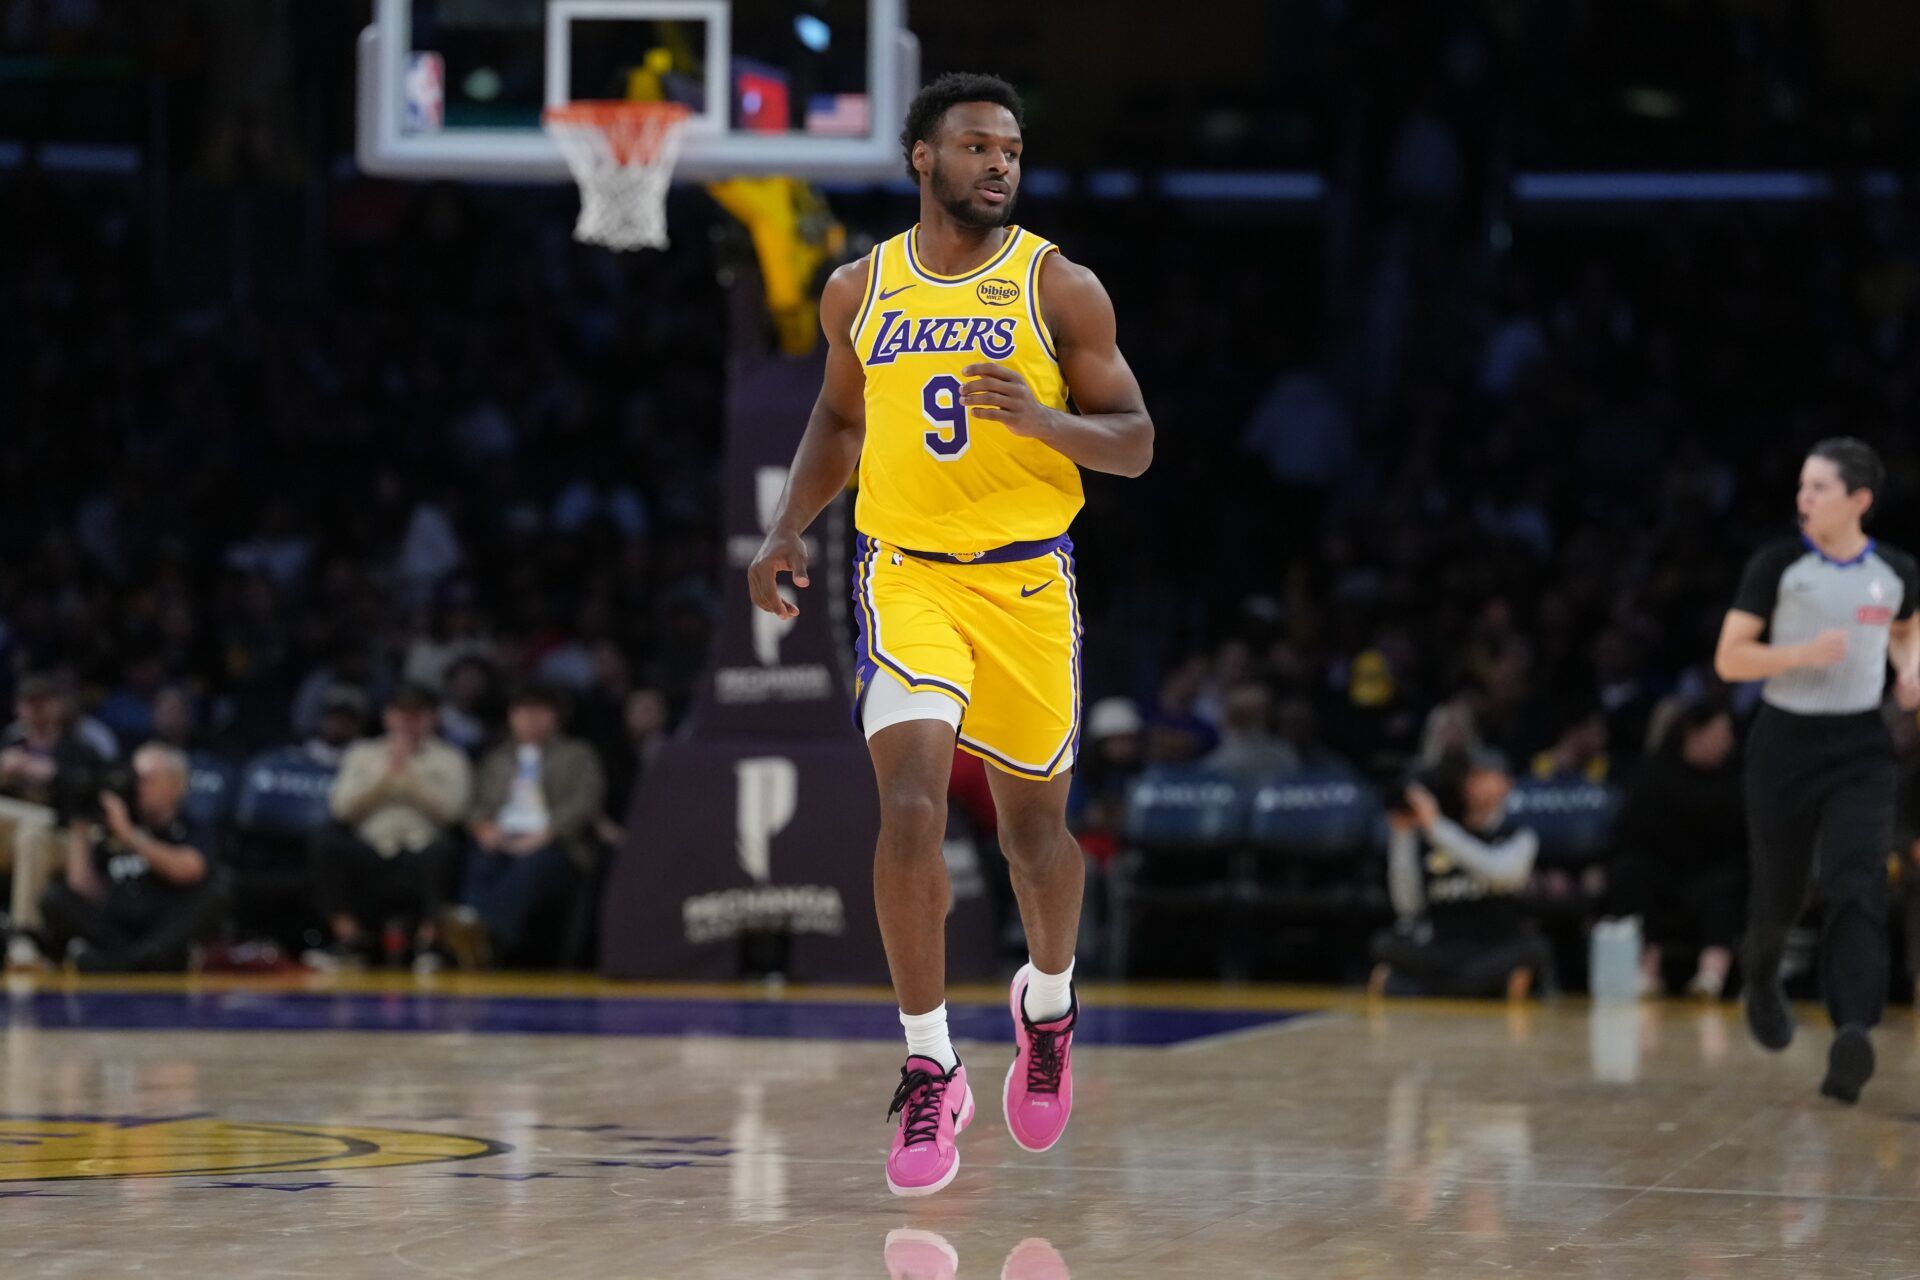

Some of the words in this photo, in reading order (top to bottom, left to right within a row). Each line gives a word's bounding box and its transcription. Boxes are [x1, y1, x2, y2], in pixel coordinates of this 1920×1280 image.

[980, 285, 1017, 299] bibigo
[866, 310, 1018, 365] LAKERS
[921, 374, 971, 462] 9
